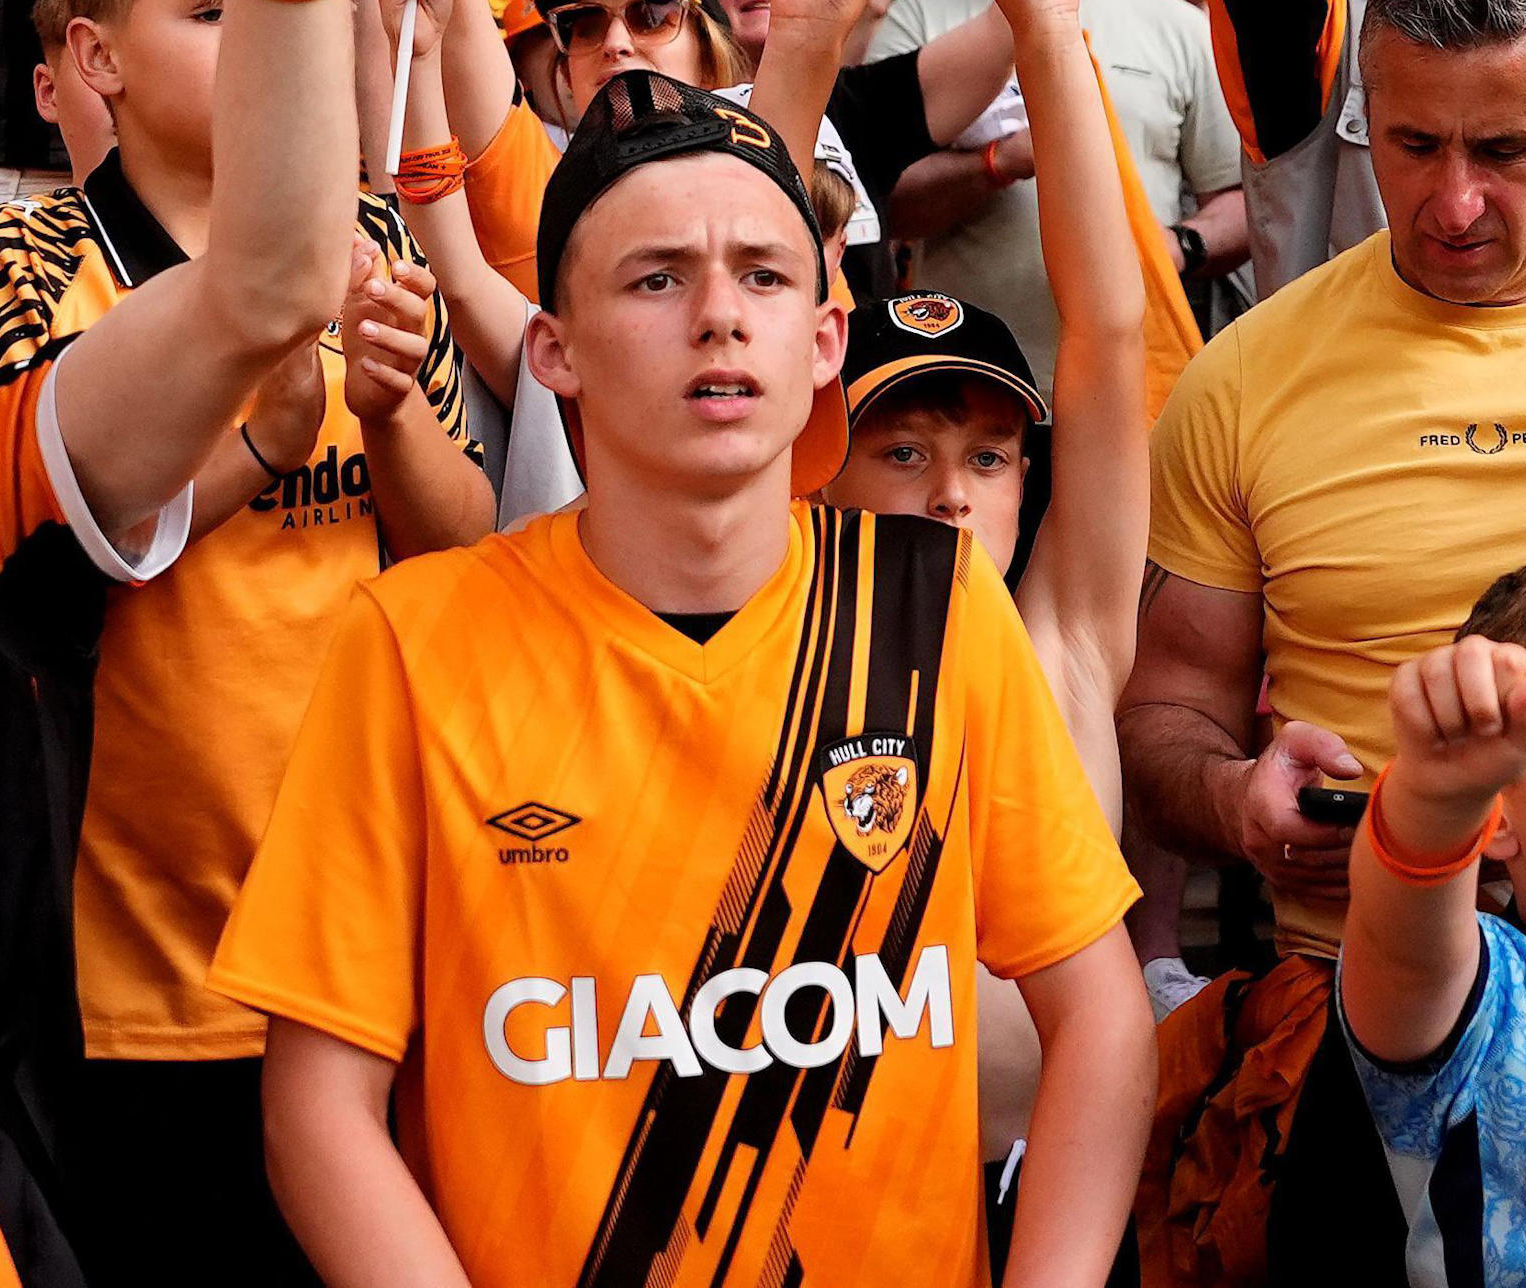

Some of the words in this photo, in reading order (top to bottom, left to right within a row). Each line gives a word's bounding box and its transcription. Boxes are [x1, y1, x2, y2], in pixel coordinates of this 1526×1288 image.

[1420, 435, 1461, 447] FRED
[828, 740, 868, 766] HULL
[871, 737, 906, 757] CITY
[498, 845, 570, 865] umbro
[482, 944, 955, 1086] GIACOM
